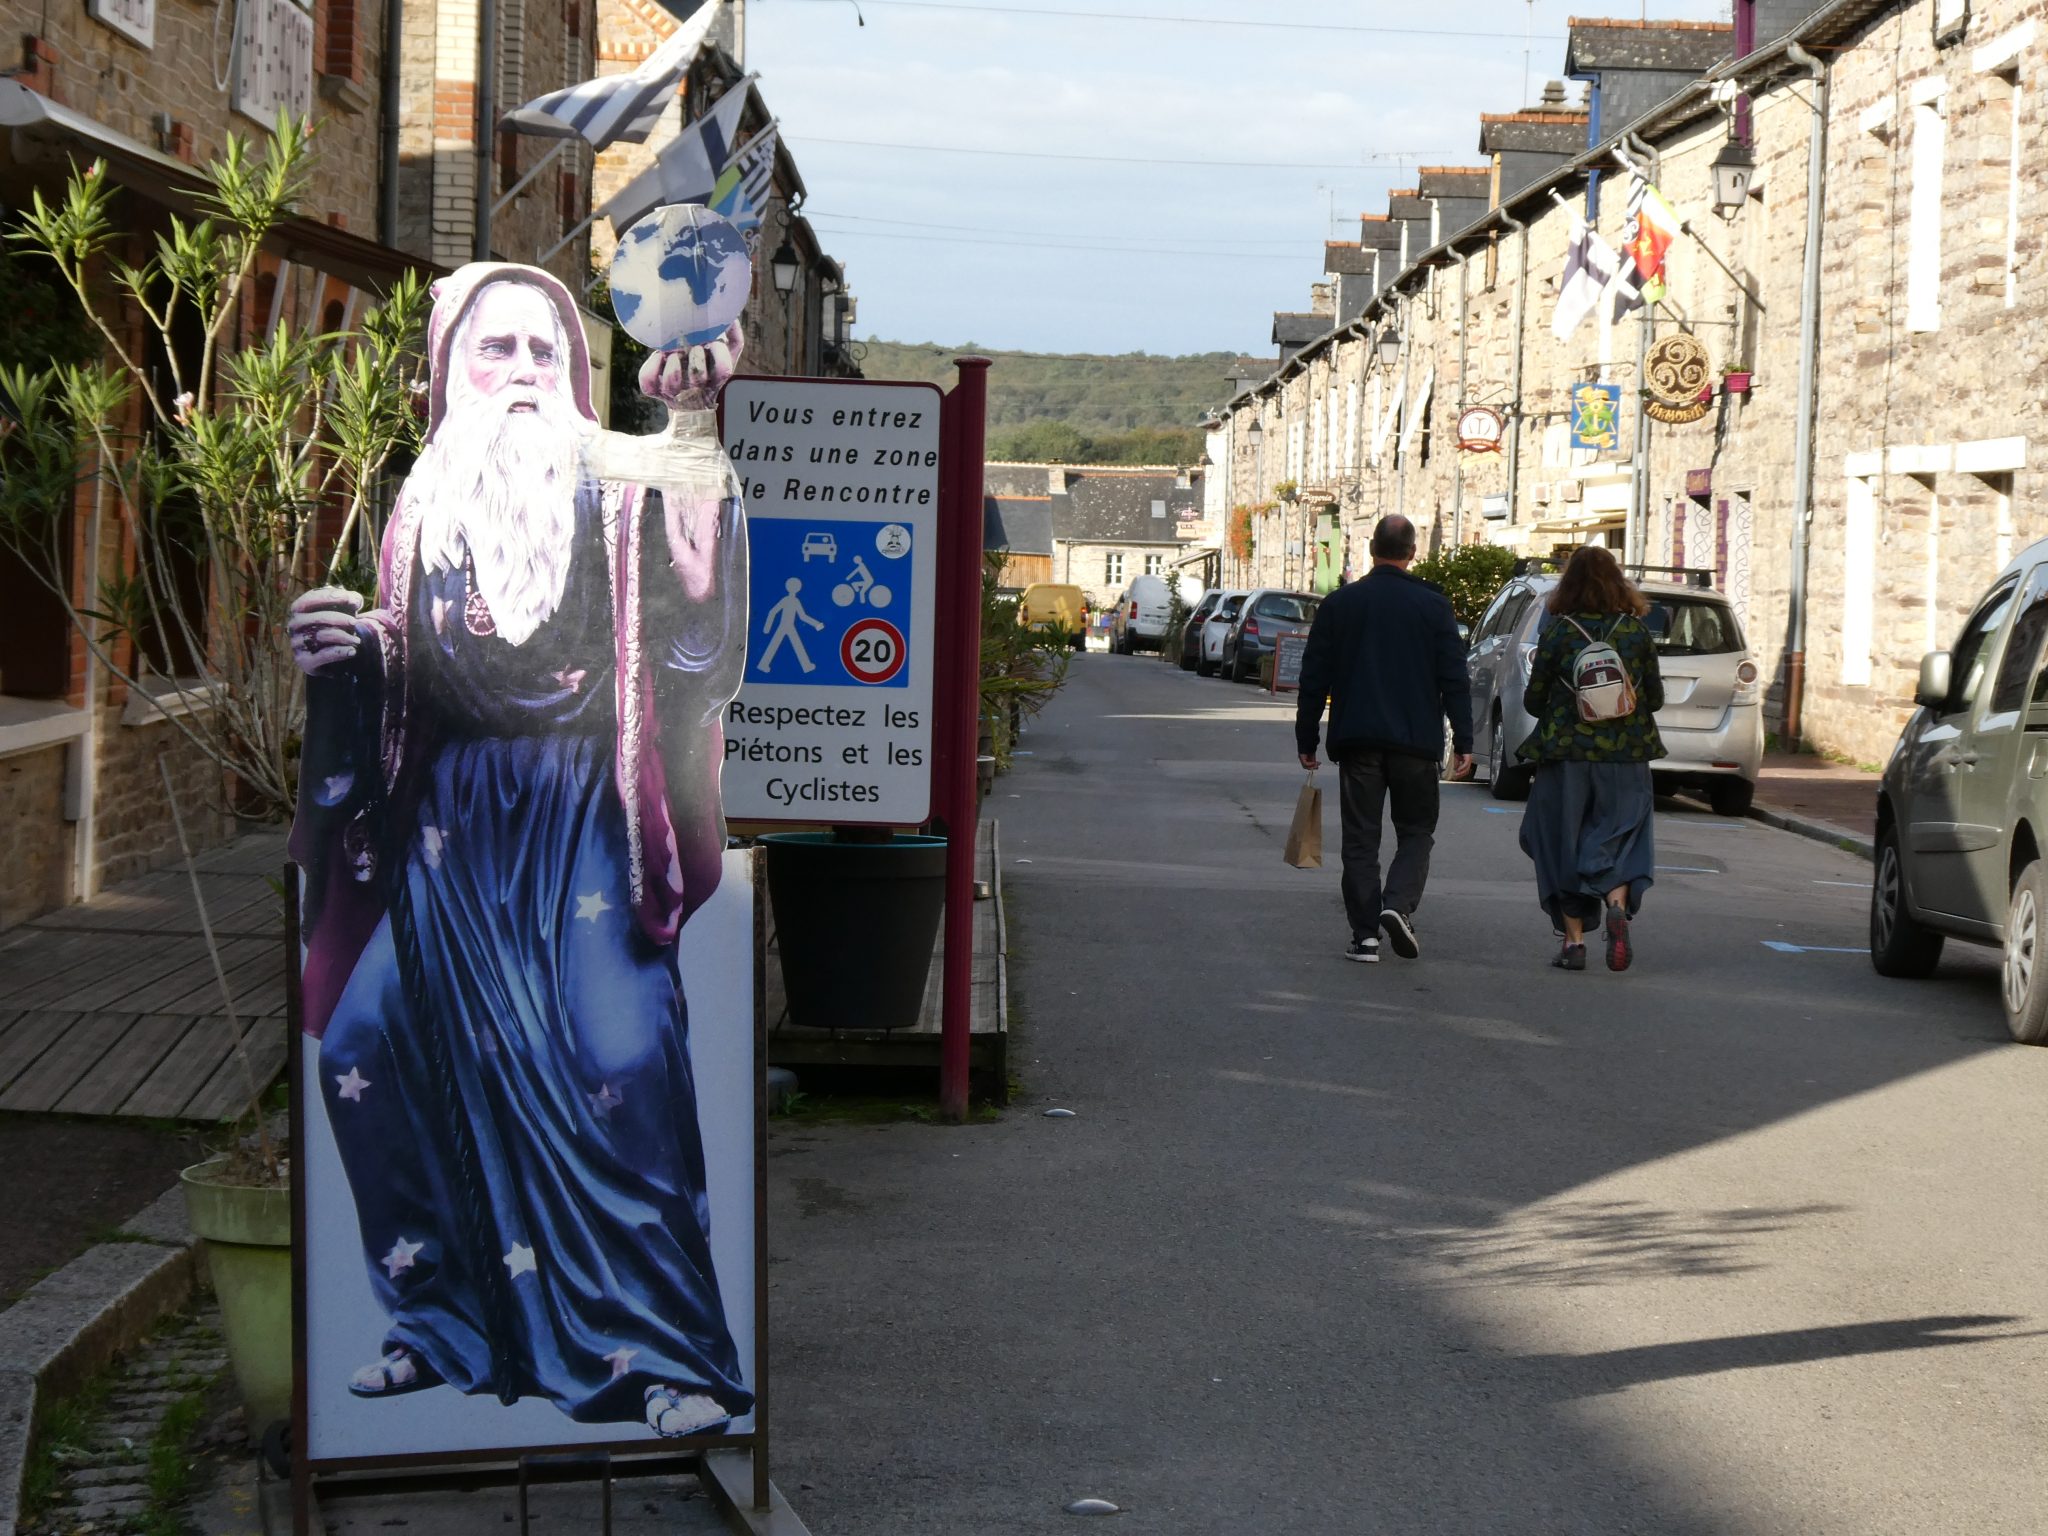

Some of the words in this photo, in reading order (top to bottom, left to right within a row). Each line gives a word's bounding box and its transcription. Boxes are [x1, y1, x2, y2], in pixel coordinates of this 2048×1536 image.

[749, 400, 814, 425] Vous
[832, 407, 922, 429] entrez
[729, 438, 794, 462] dans
[809, 447, 859, 465] une
[873, 449, 937, 468] zone
[783, 478, 931, 505] Rencontre
[855, 639, 891, 663] 20
[729, 701, 866, 731] Respectez
[884, 703, 919, 729] les
[724, 737, 823, 764] Piétons
[842, 743, 869, 765] et
[888, 741, 923, 767] les
[766, 777, 880, 806] Cyclistes
